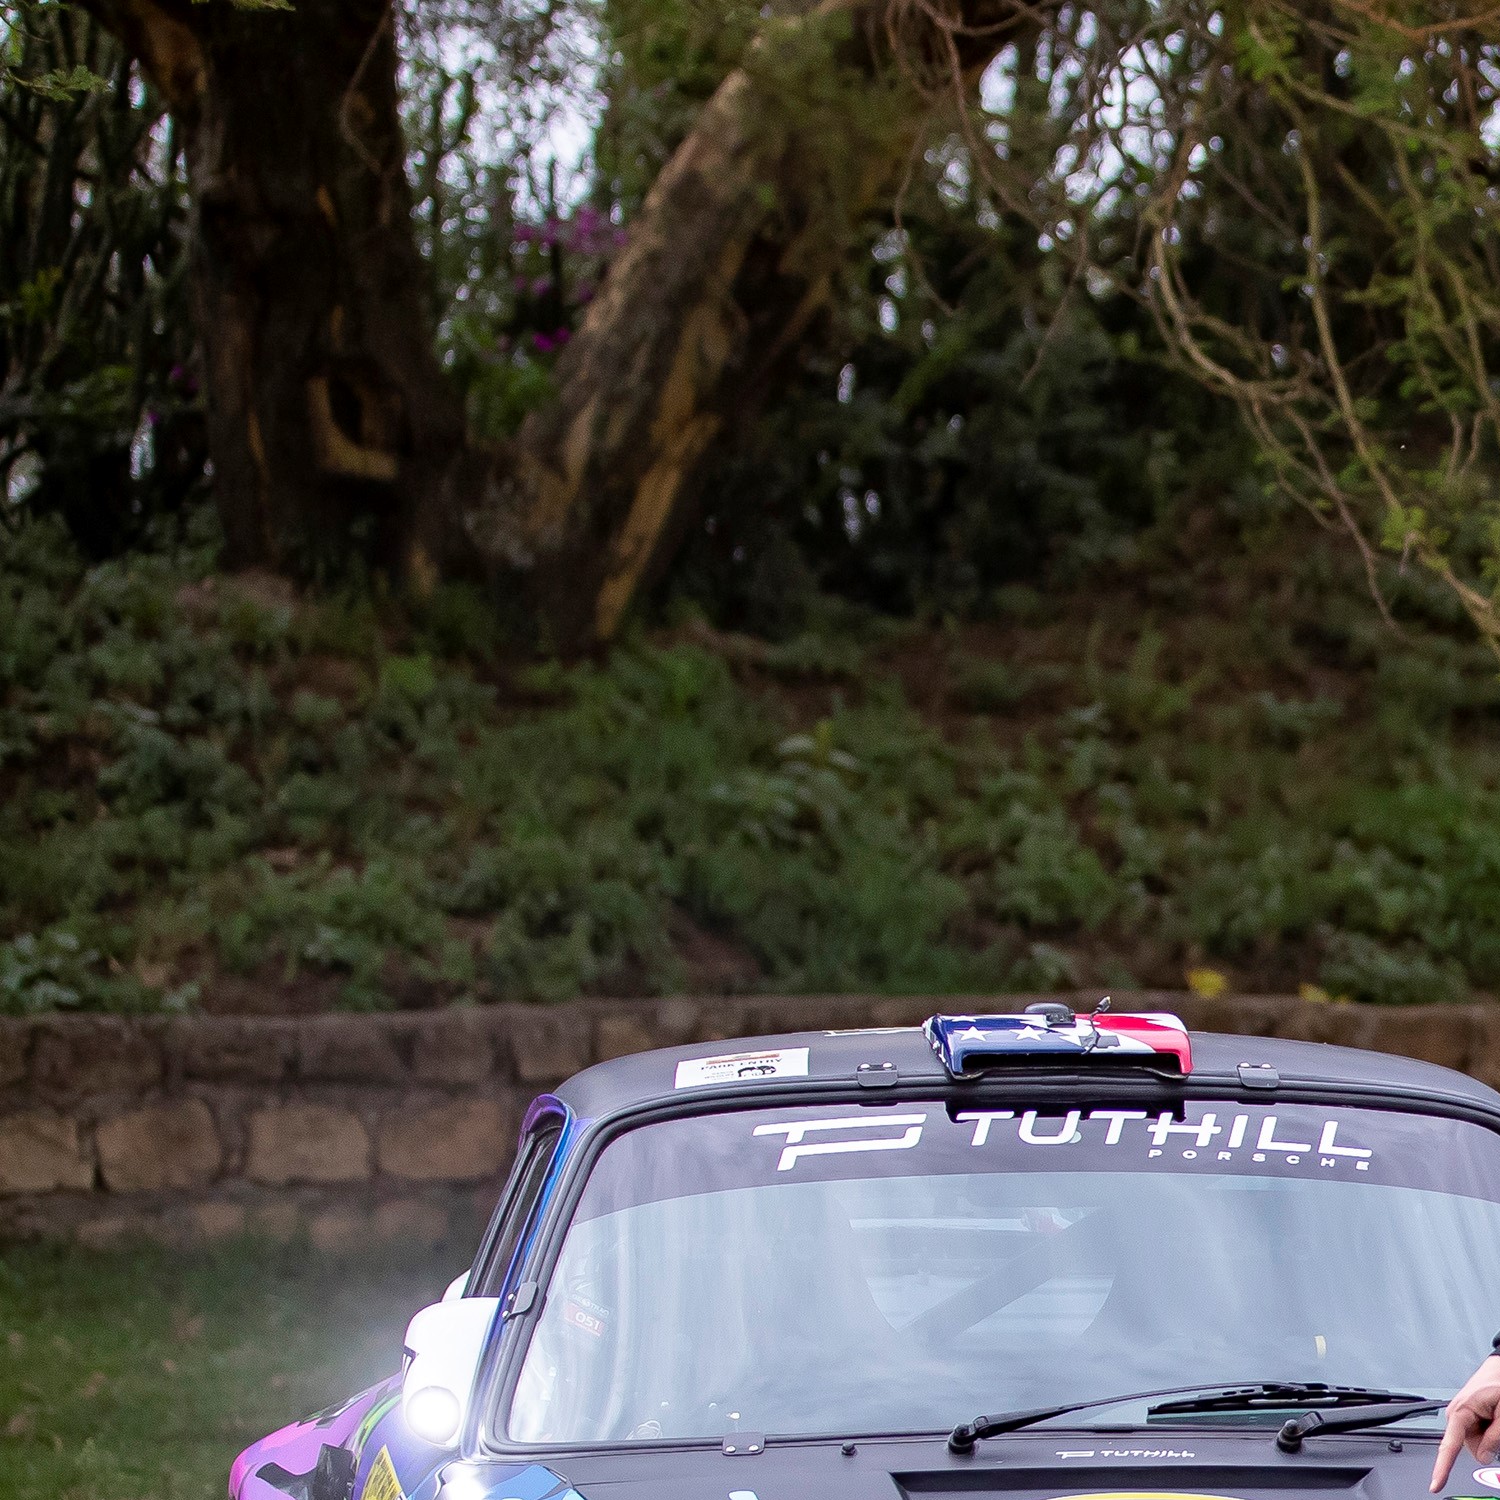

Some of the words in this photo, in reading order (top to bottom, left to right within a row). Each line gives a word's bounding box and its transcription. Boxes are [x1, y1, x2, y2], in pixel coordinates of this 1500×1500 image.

[956, 1110, 1373, 1159] TUTHILL
[1148, 1149, 1370, 1171] PORSCHE
[1101, 1450, 1195, 1458] TUTHILL
